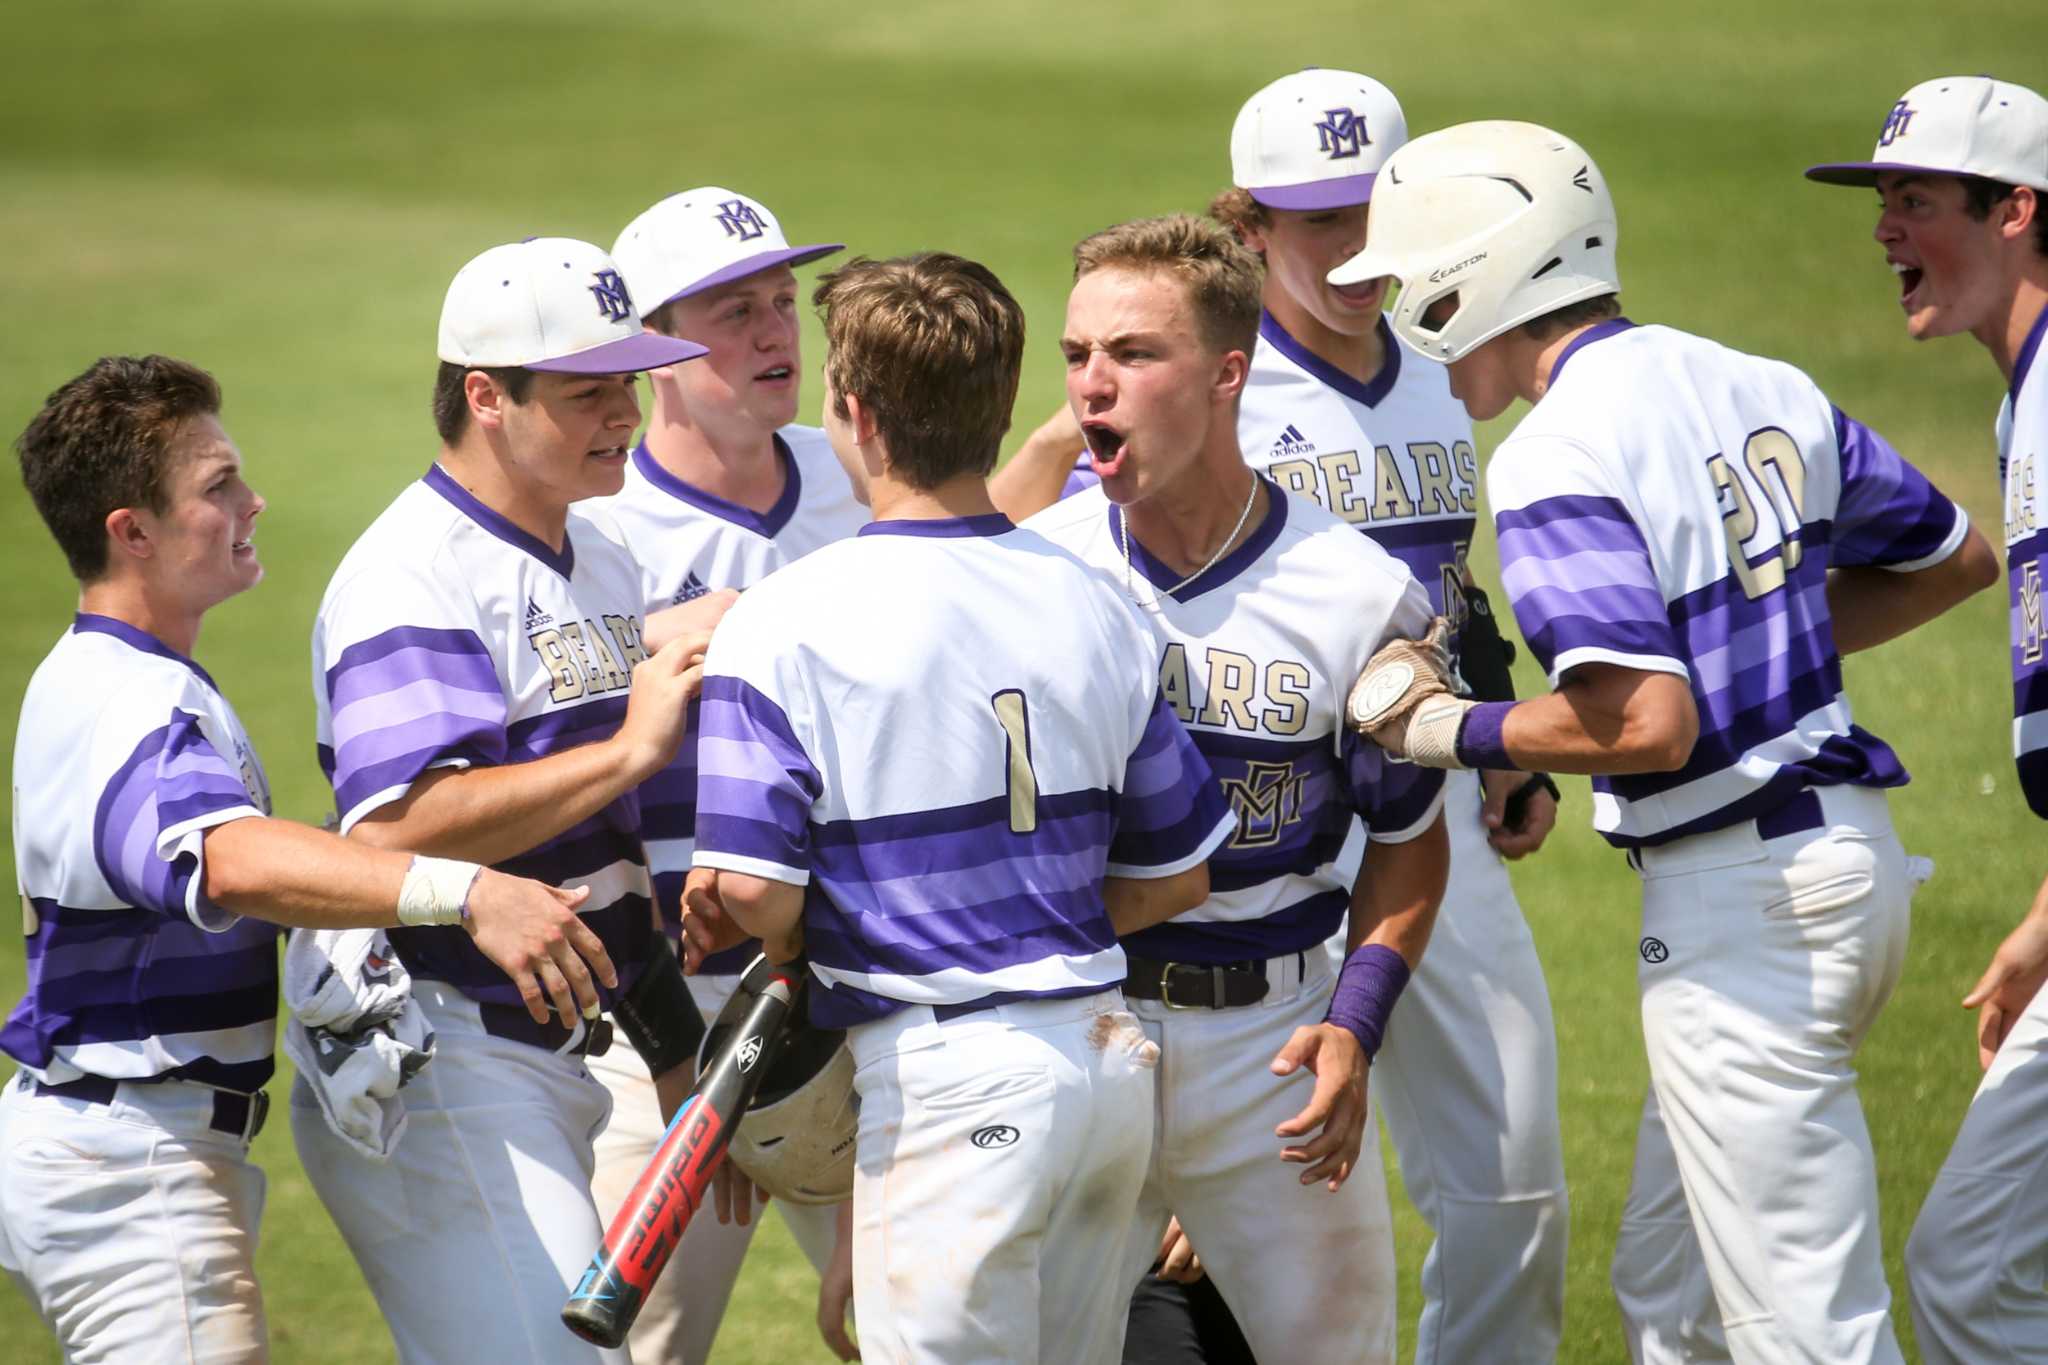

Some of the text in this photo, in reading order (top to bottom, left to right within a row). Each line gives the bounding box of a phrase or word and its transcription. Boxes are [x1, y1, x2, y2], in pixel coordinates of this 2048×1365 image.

[1440, 251, 1488, 279] EASTON
[1269, 441, 1316, 458] adidas
[1706, 425, 1807, 601] 20
[993, 688, 1039, 833] 1
